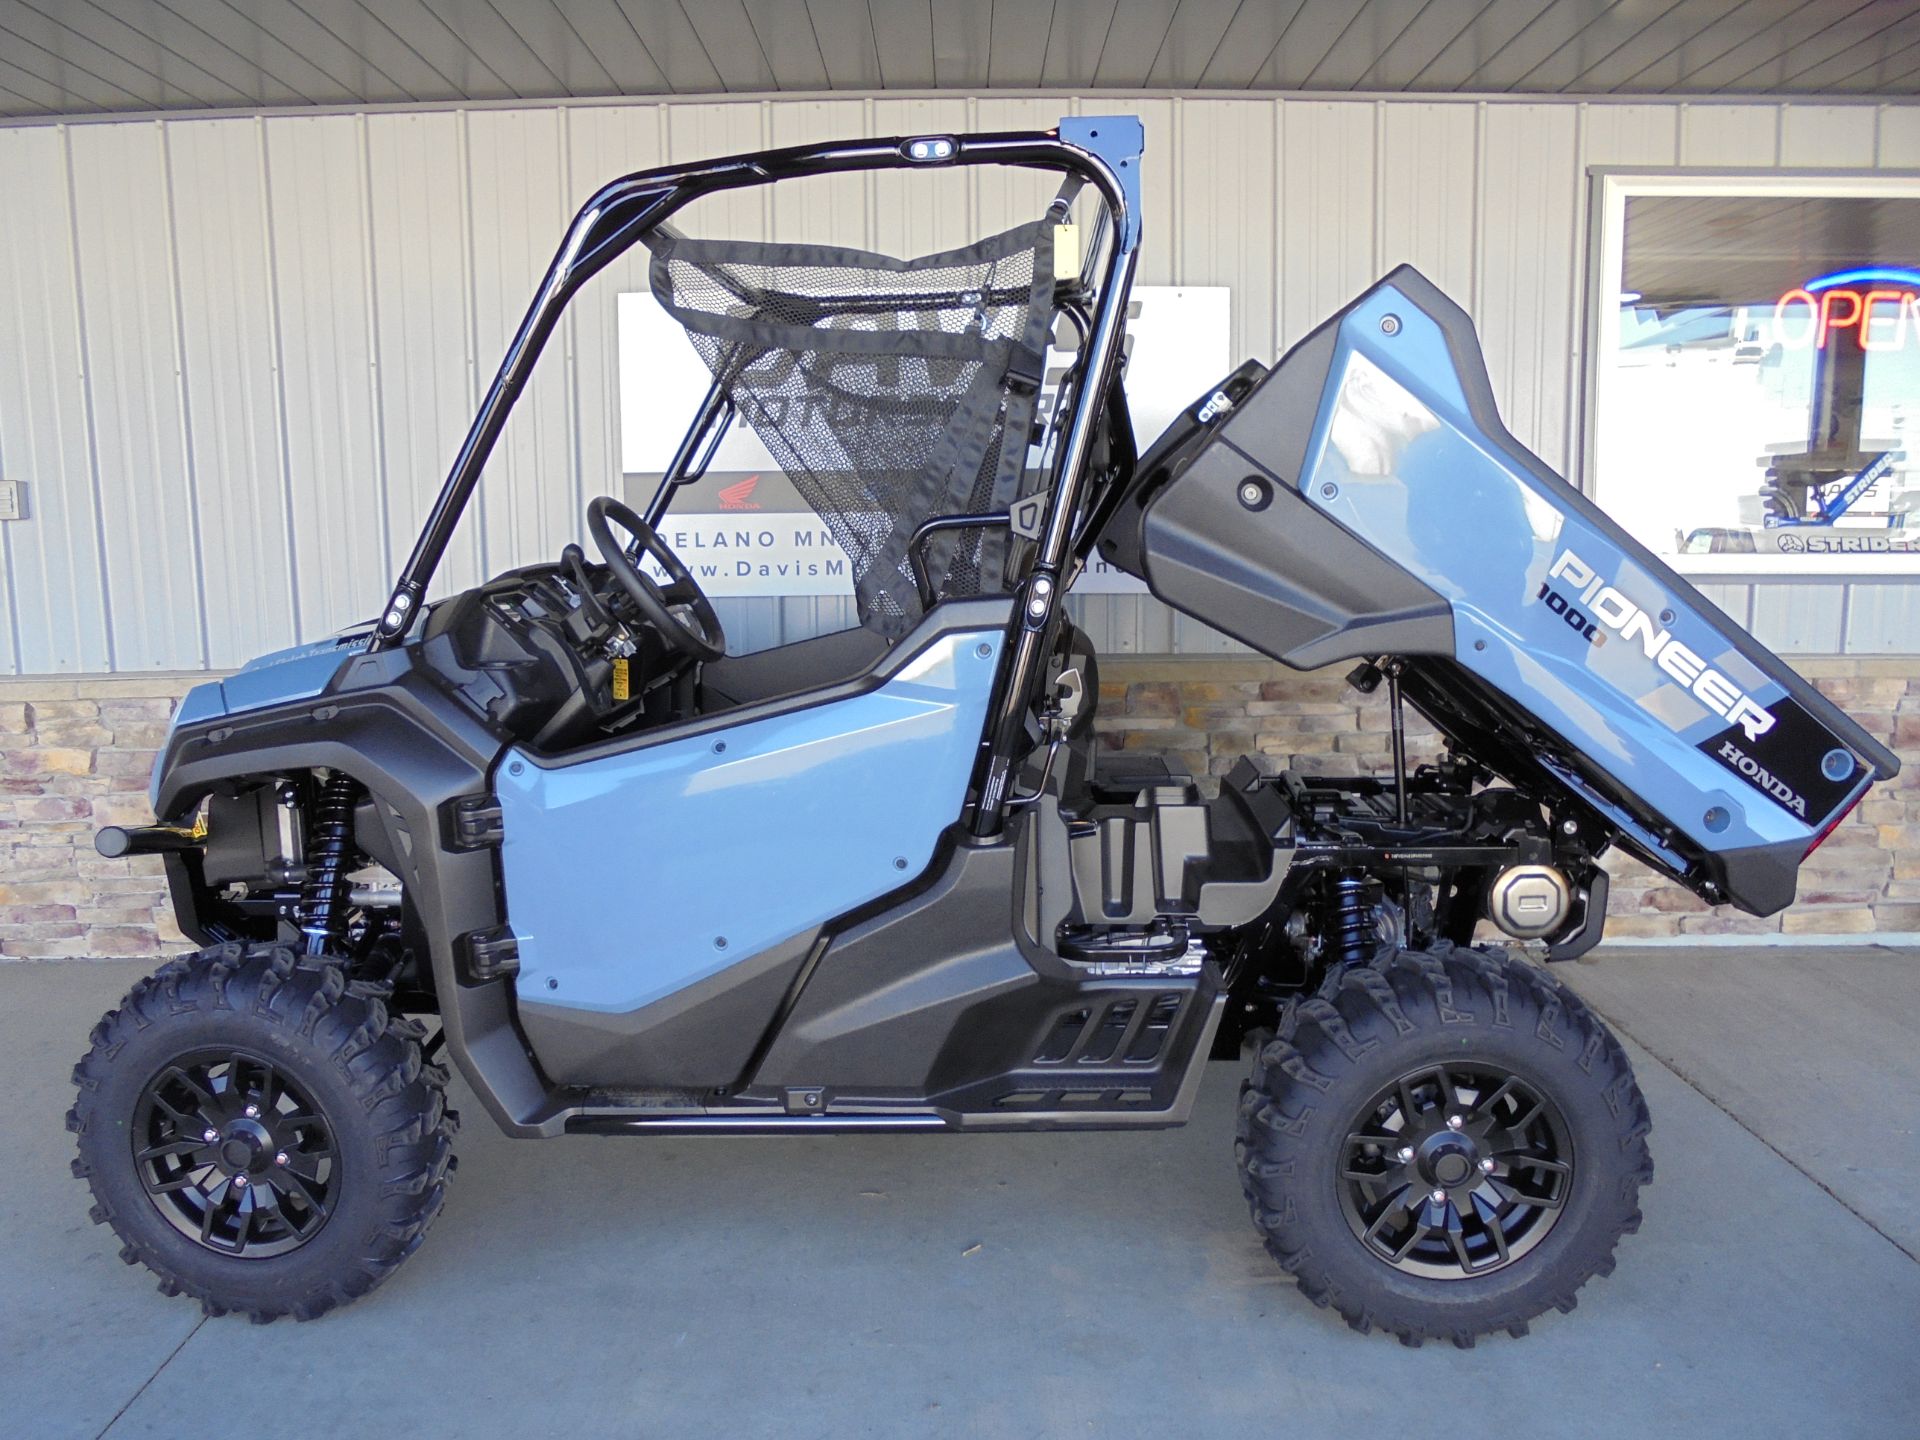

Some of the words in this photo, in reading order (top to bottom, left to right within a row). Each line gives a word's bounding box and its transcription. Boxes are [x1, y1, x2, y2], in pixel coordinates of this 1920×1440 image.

[1844, 452, 1892, 504] STRIDER
[794, 531, 835, 547] MN
[1537, 581, 1607, 648] 1000
[1549, 549, 1776, 742] PIONEER
[1718, 741, 1805, 817] HONDA
